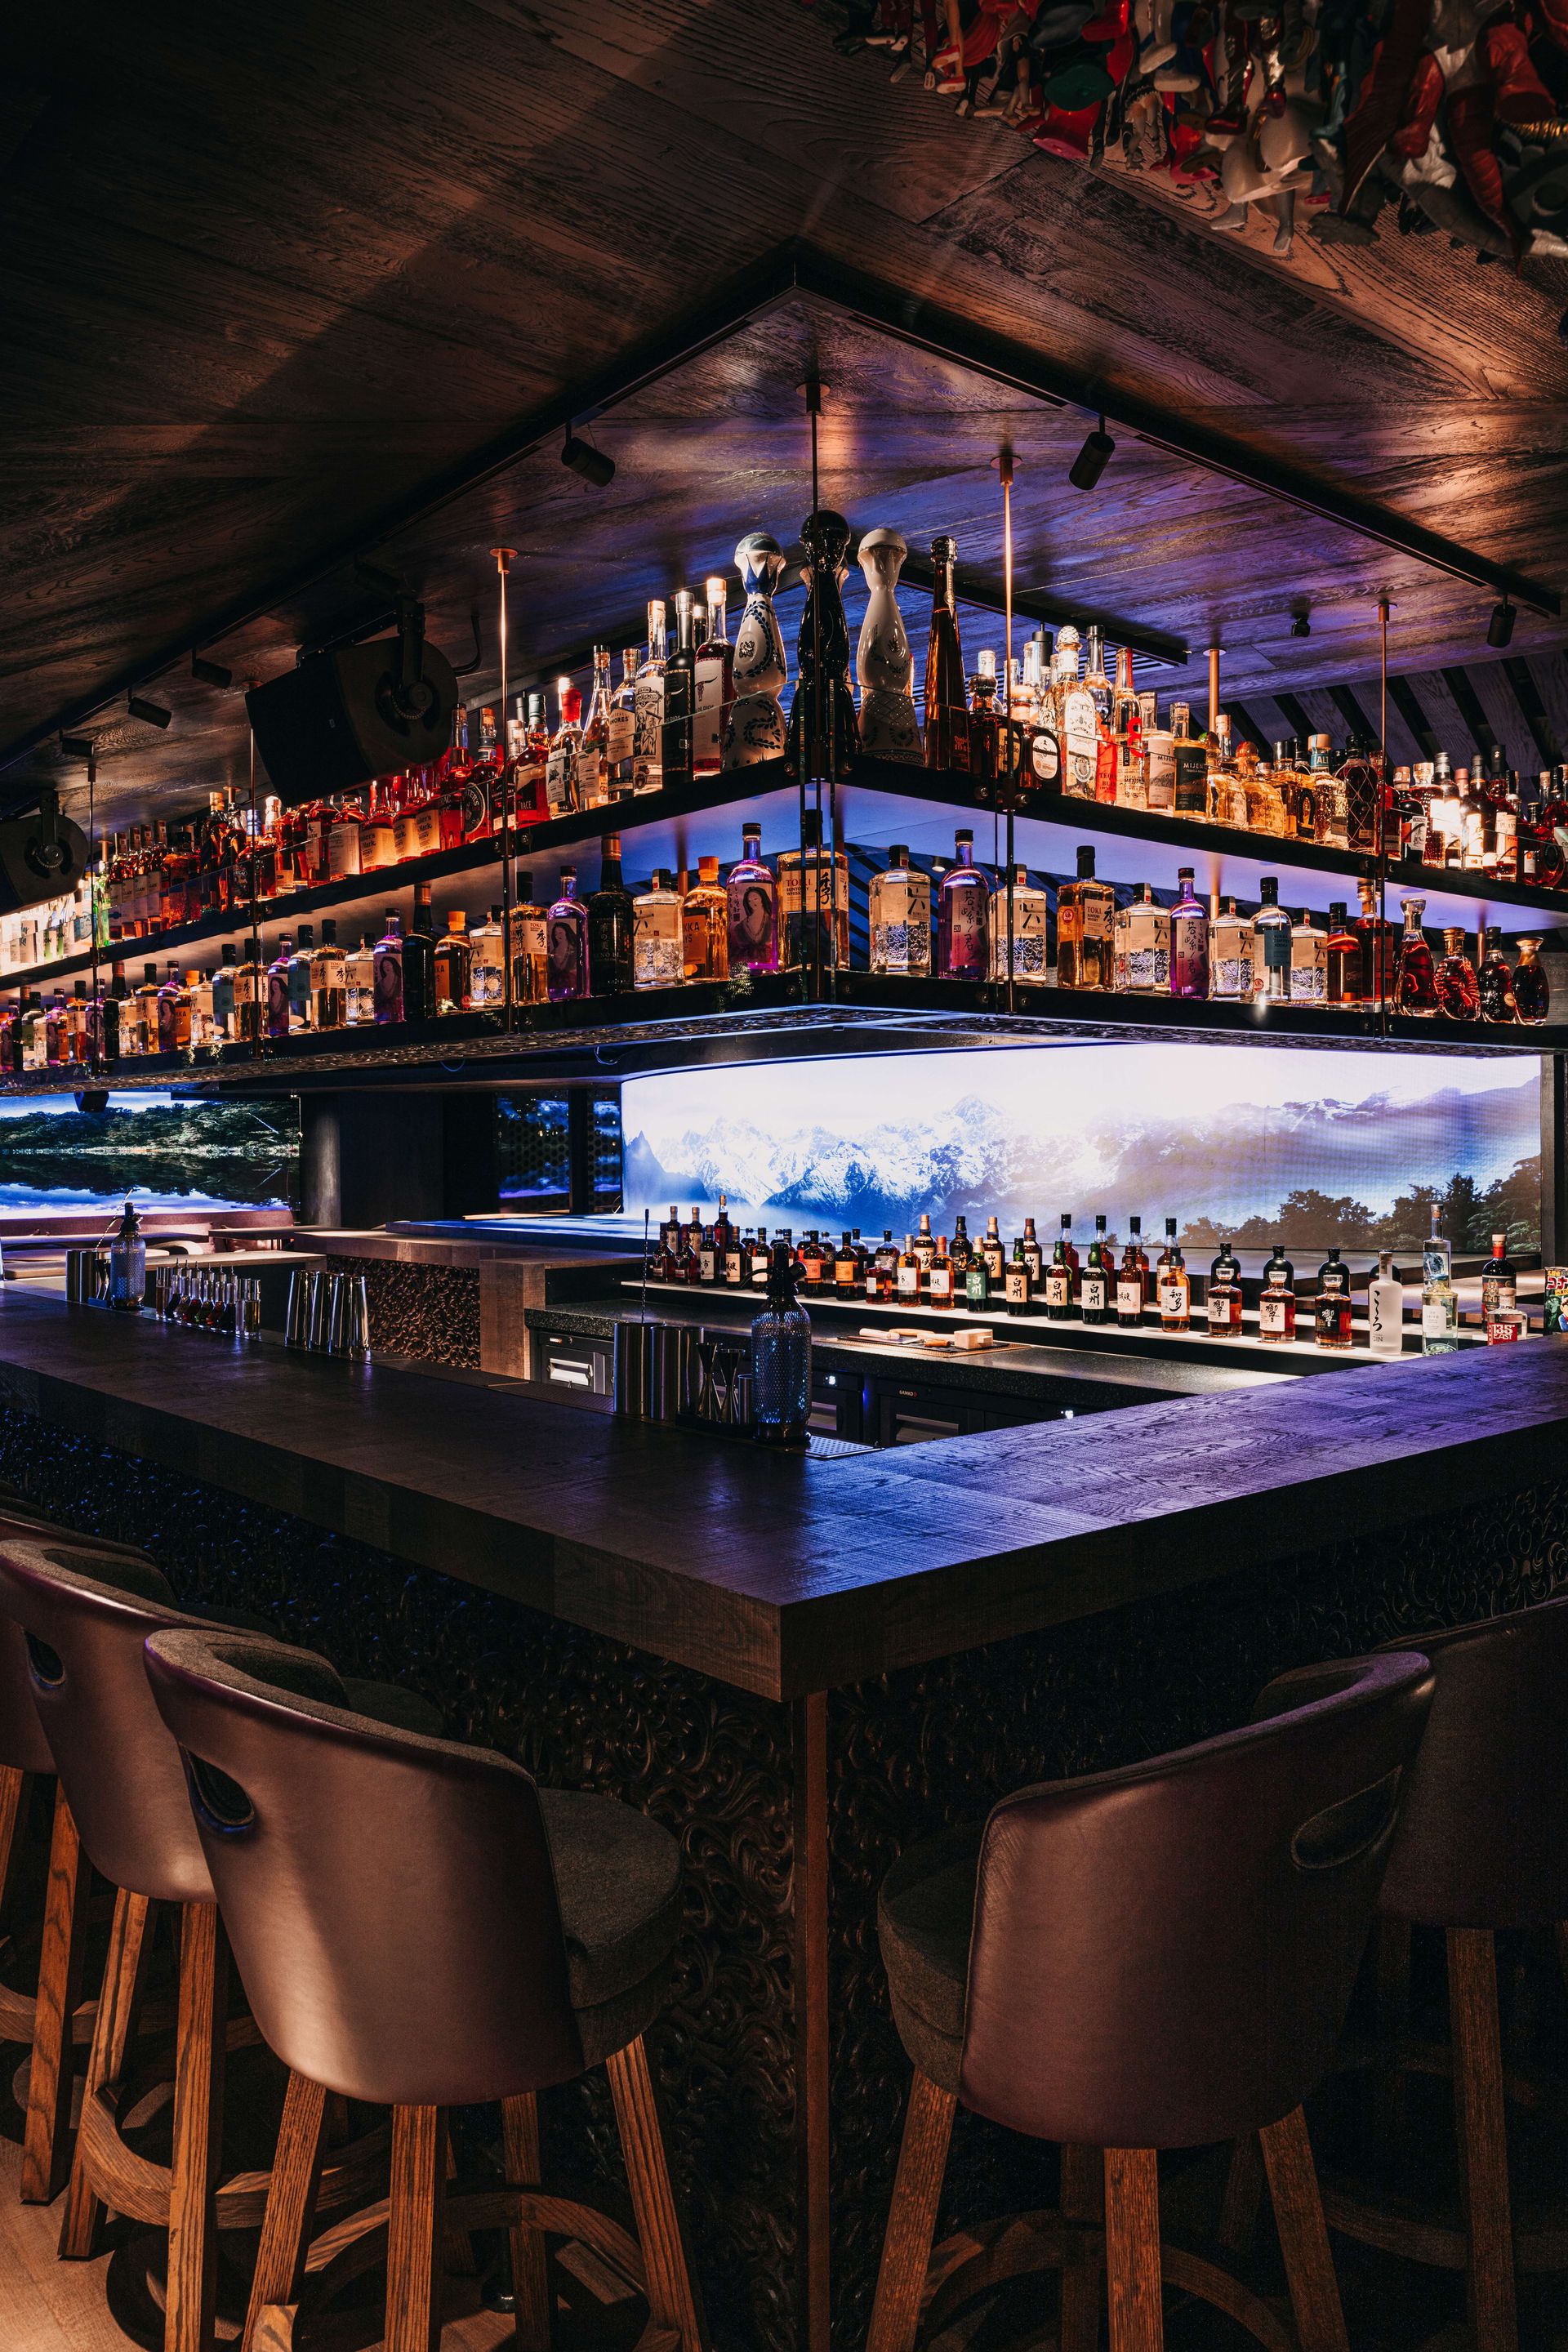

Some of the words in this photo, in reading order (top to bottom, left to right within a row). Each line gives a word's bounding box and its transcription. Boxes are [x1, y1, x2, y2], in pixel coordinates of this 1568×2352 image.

[972, 1274, 983, 1295] 白州
[1012, 1277, 1022, 1298] 白州
[1052, 1281, 1062, 1302] 白州
[1546, 1276, 1568, 1290] コナ
[1089, 1284, 1100, 1306] 白州
